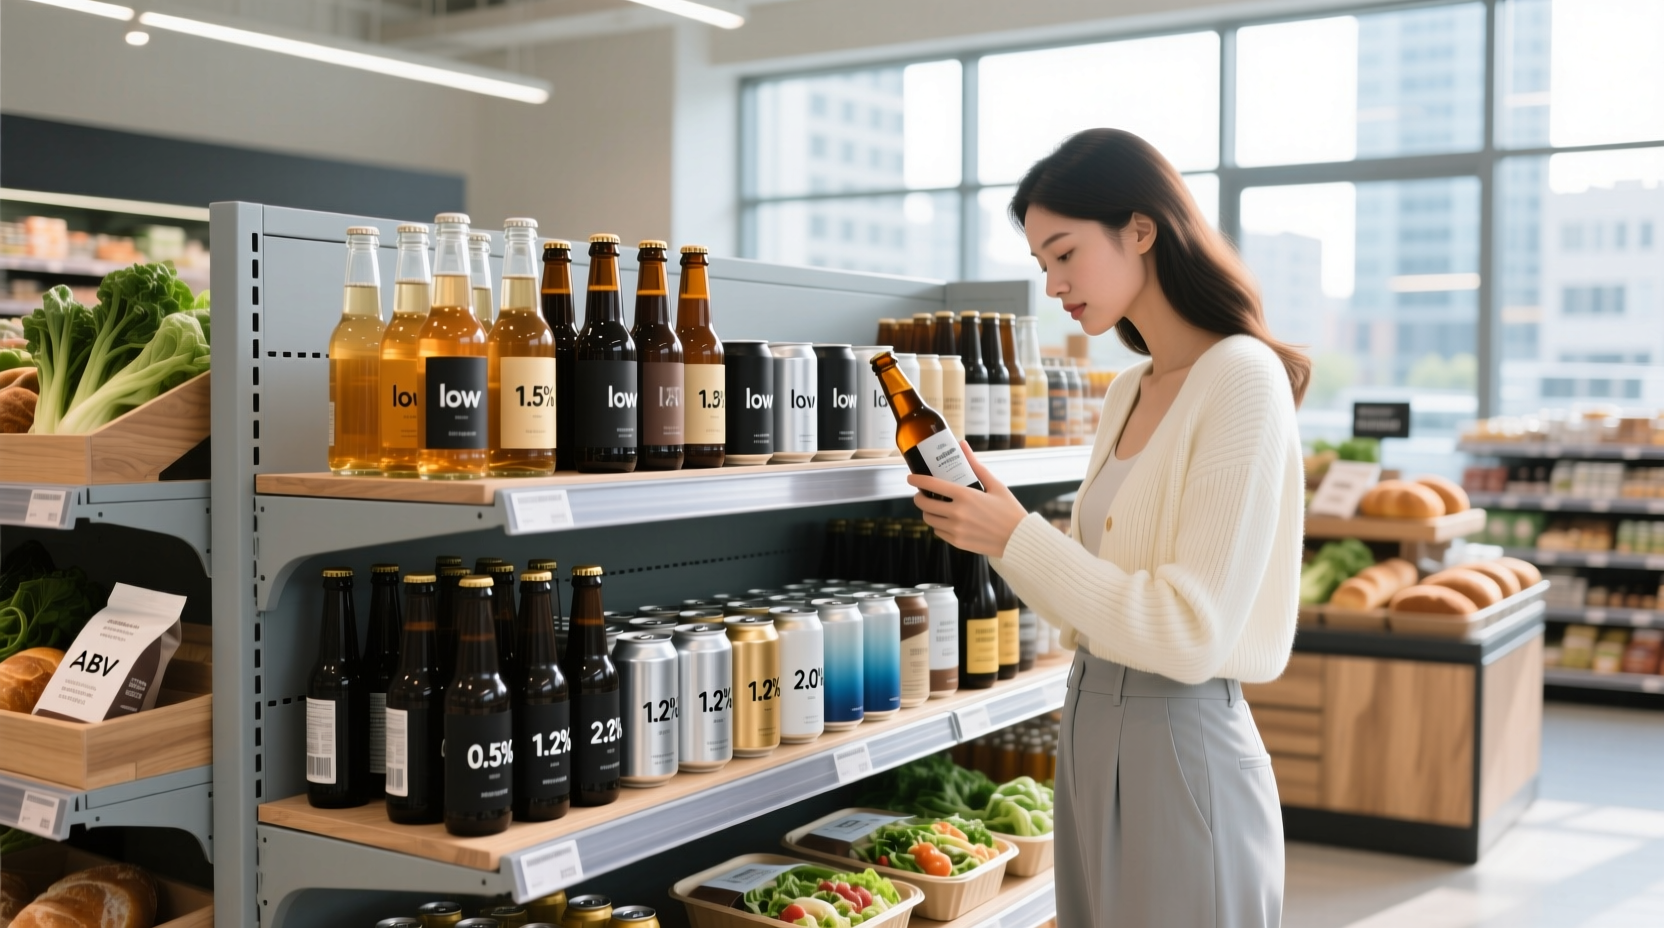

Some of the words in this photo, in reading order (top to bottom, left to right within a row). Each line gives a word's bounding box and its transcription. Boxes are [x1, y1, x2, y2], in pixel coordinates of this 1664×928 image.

[393, 384, 418, 408] lo
[439, 383, 482, 408] low
[515, 385, 555, 407] 1.5%
[608, 385, 637, 408] low
[746, 388, 773, 409] low
[833, 388, 857, 408] low
[69, 650, 120, 677] ABV
[698, 687, 732, 713] 1.2%
[748, 677, 780, 702] 1.2%
[467, 739, 513, 770] 0.5%
[532, 727, 571, 757] 1.2%
